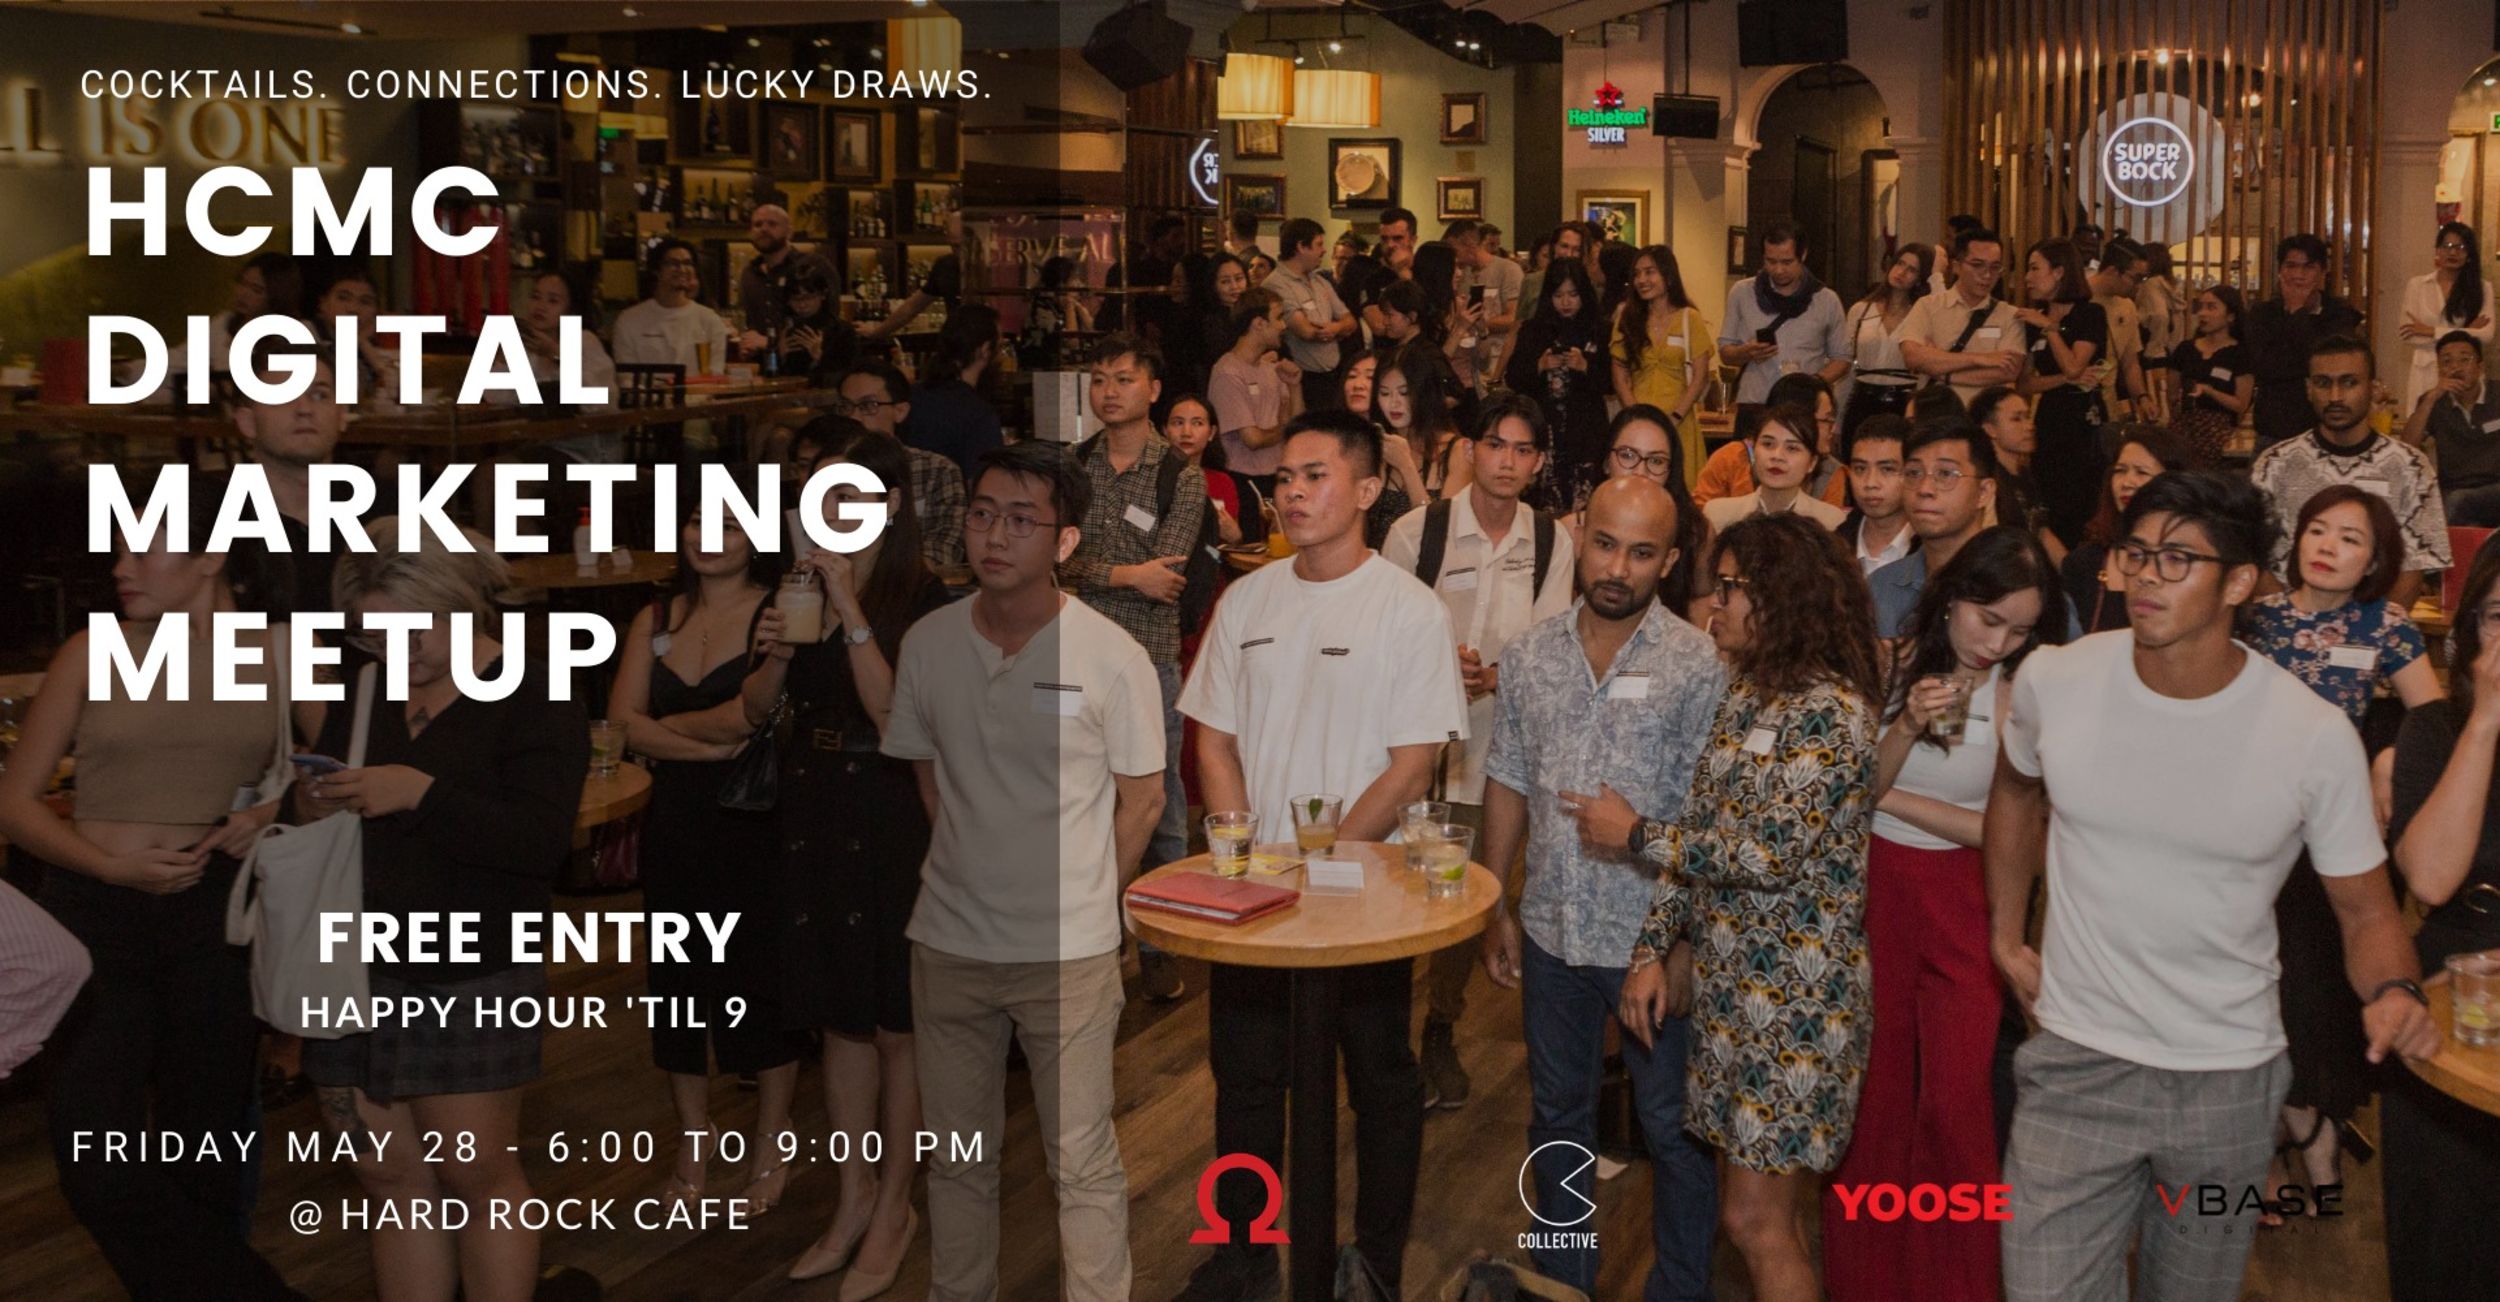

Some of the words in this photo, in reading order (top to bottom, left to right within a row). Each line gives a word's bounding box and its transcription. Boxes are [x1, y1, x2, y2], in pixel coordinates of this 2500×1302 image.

[1567, 107, 1648, 127] Heineken
[189, 99, 346, 163] ONE
[1587, 126, 1626, 143] SILVER
[2114, 142, 2181, 162] SUPER
[2118, 161, 2177, 181] BOCK
